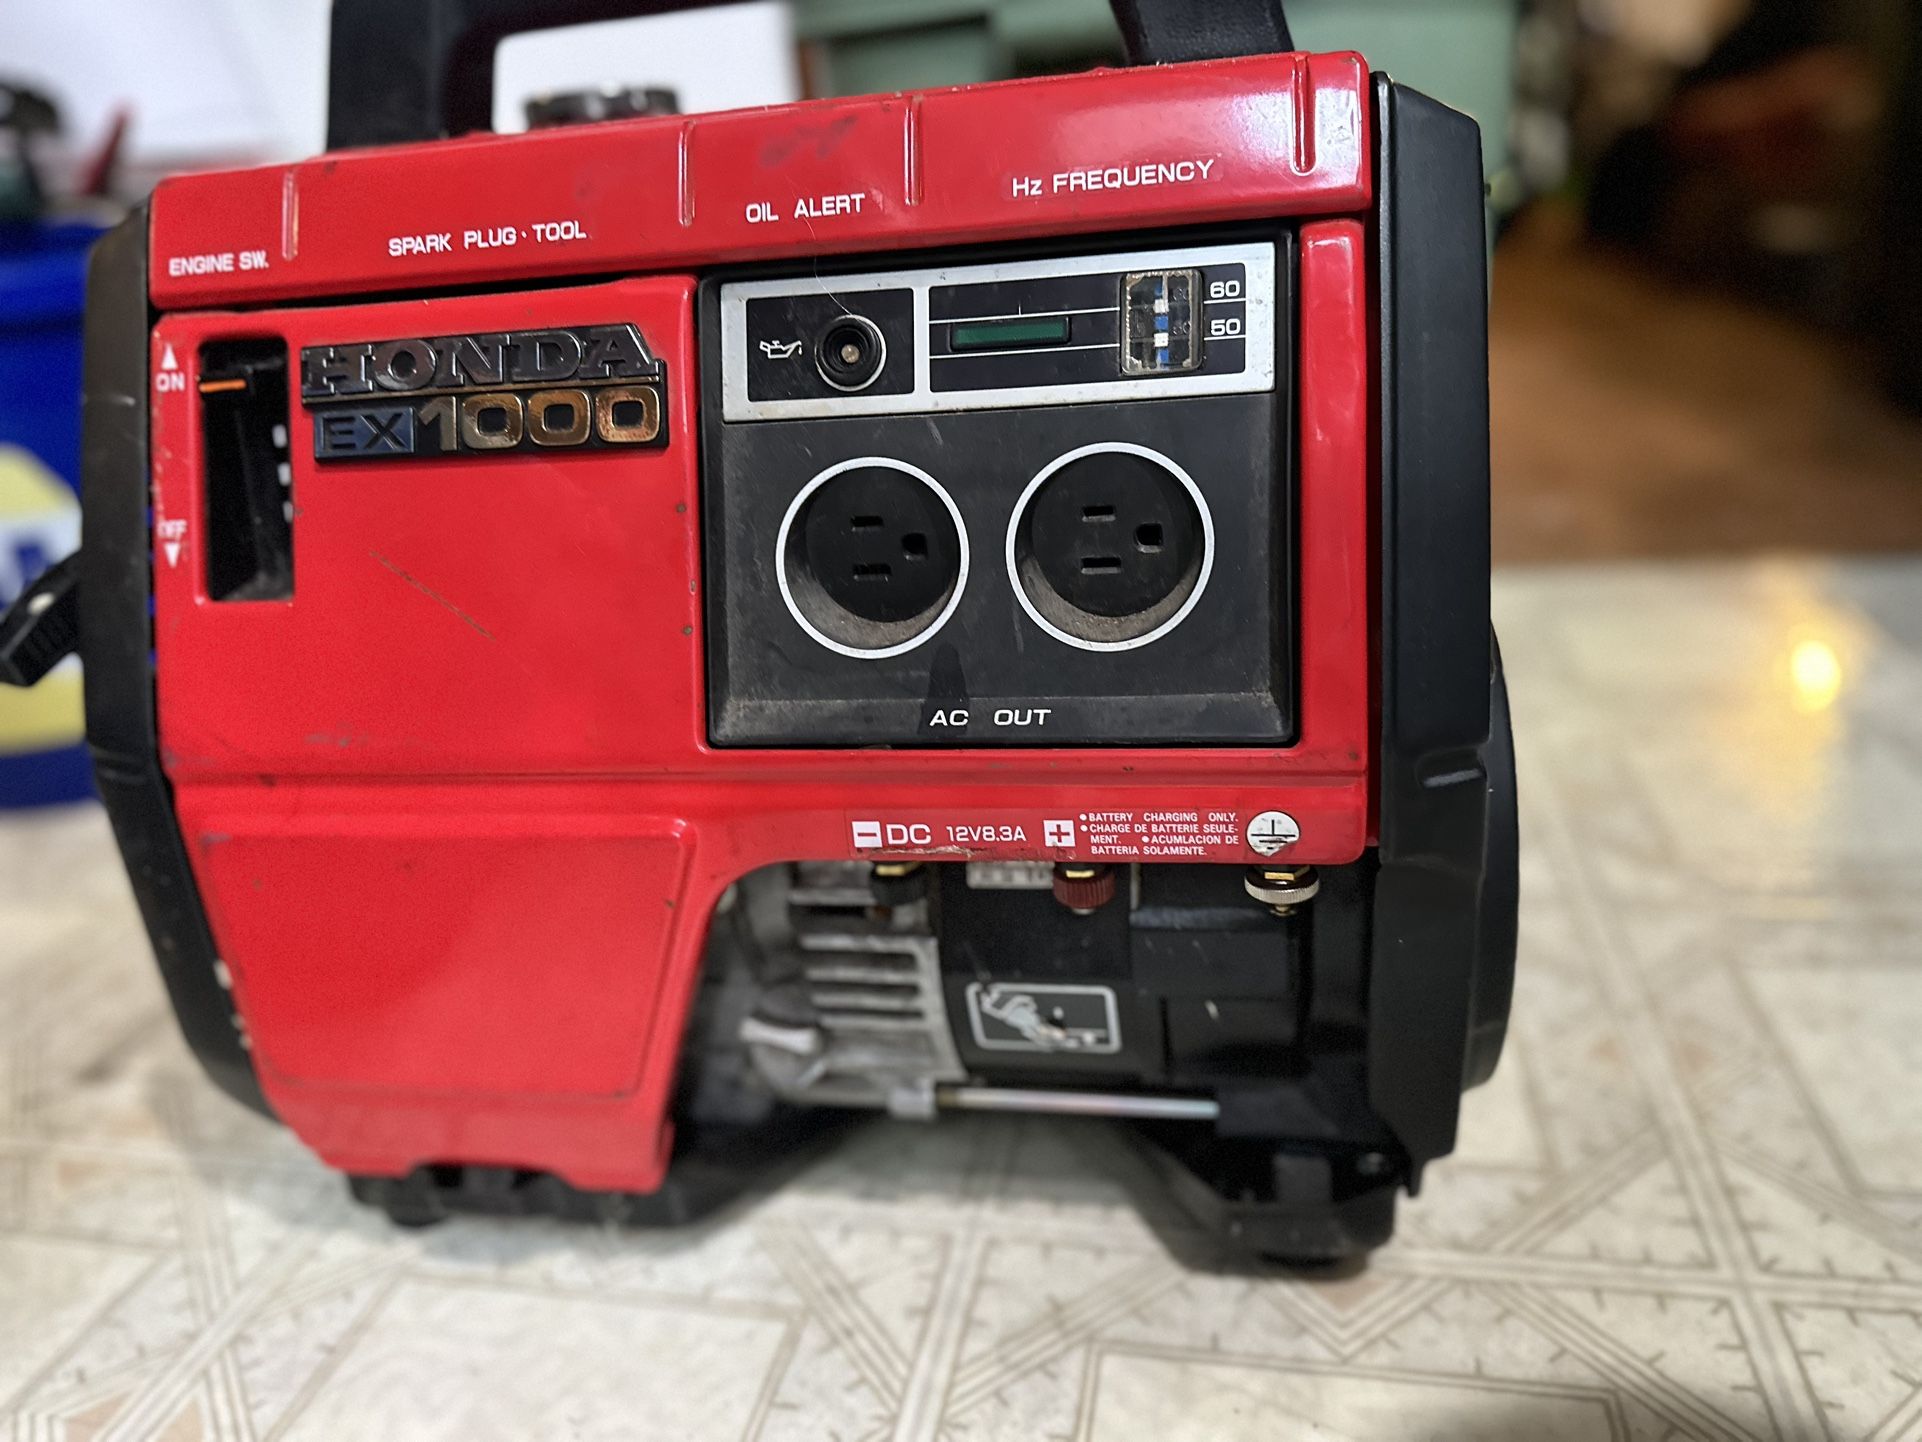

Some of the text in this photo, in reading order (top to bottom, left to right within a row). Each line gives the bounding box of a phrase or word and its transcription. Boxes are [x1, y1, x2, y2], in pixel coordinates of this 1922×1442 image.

[1012, 159, 1214, 197] Hz FREQUENCY
[745, 193, 866, 223] OIL ALERT
[388, 233, 452, 256] SPARK
[532, 220, 587, 242] TOOL
[168, 251, 269, 276] ENGINE SW.
[1209, 280, 1240, 298] 60
[1210, 318, 1241, 336] 50
[300, 324, 659, 395] HONDA
[155, 372, 186, 392] ON
[929, 709, 1052, 727] AC OUT
[1088, 811, 1239, 822] BATTERY CHARGING ONLY.
[885, 823, 1027, 845] DC 12V8.3A
[1089, 824, 1130, 834] CHARGE
[1134, 824, 1148, 834] DE
[1151, 824, 1200, 833] BATTERIE
[1090, 835, 1239, 845] MENT. ACUMLACION DE
[1091, 846, 1208, 856] BATTERIA SOLAMENTE.
